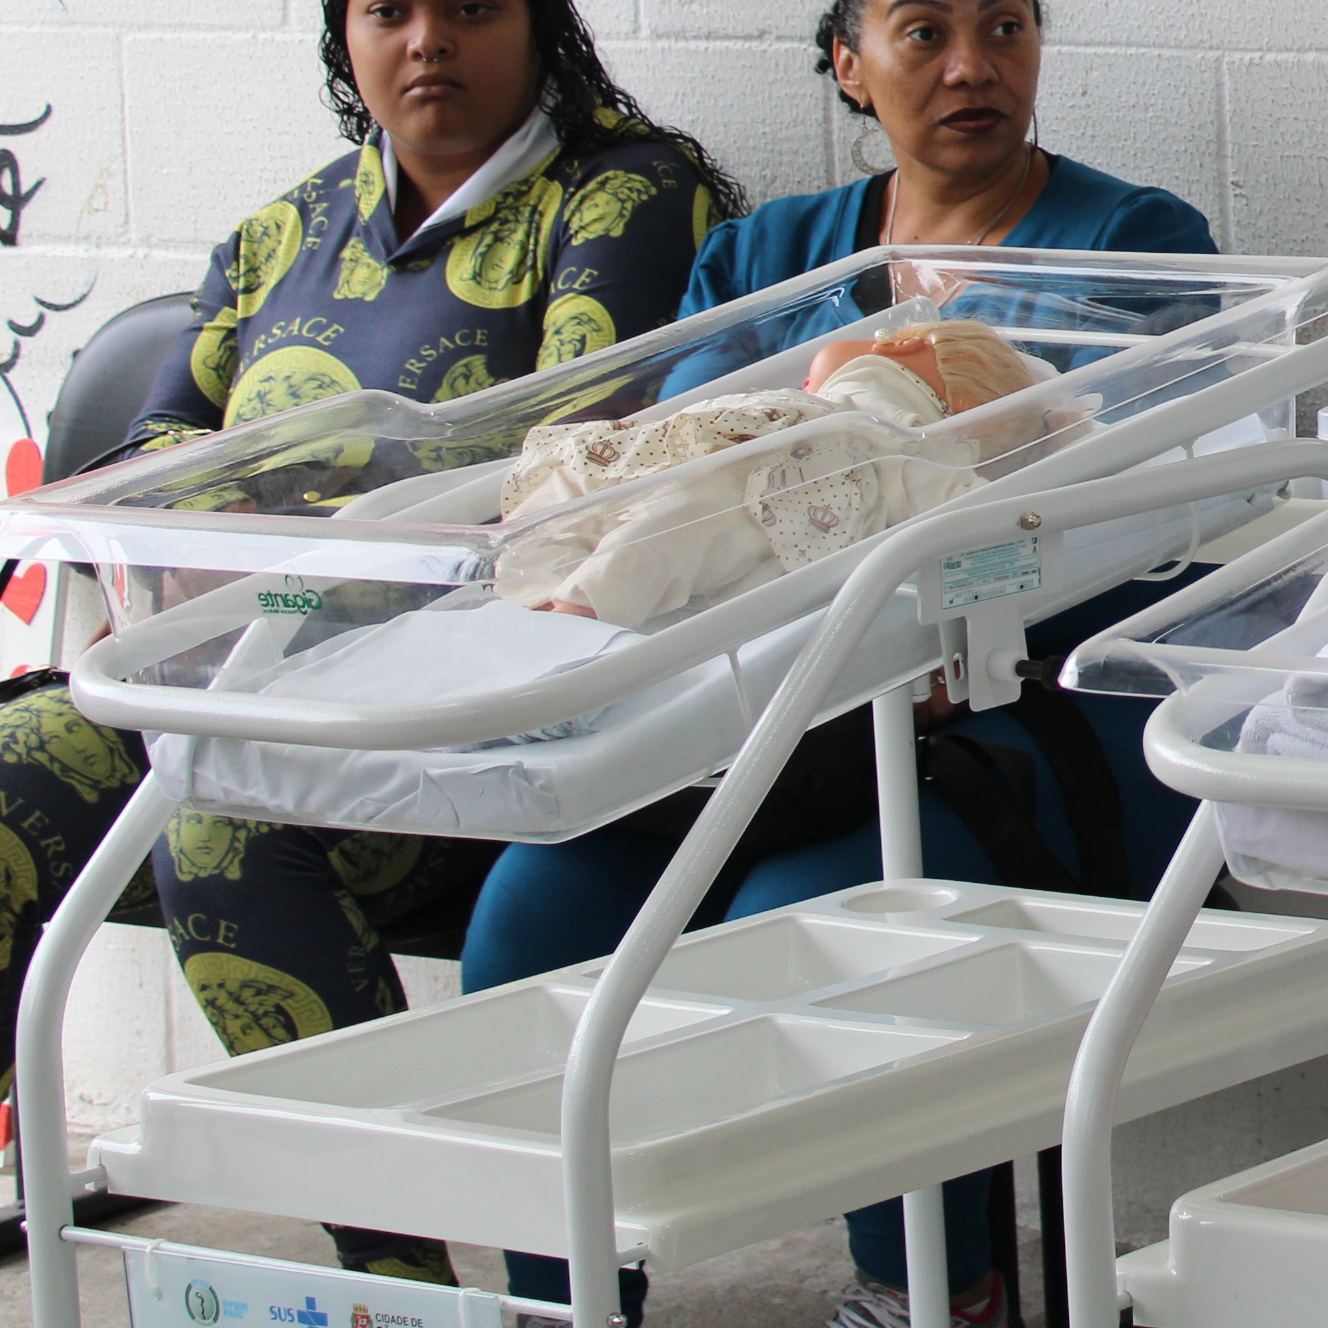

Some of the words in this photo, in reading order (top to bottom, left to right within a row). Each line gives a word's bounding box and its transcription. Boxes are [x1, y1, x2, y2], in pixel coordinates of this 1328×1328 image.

[397, 328, 488, 391] ERSACE
[0, 790, 75, 888] VERS
[269, 1305, 295, 1323] SUS
[375, 1313, 409, 1327] CIDADE
[411, 1317, 424, 1328] DE
